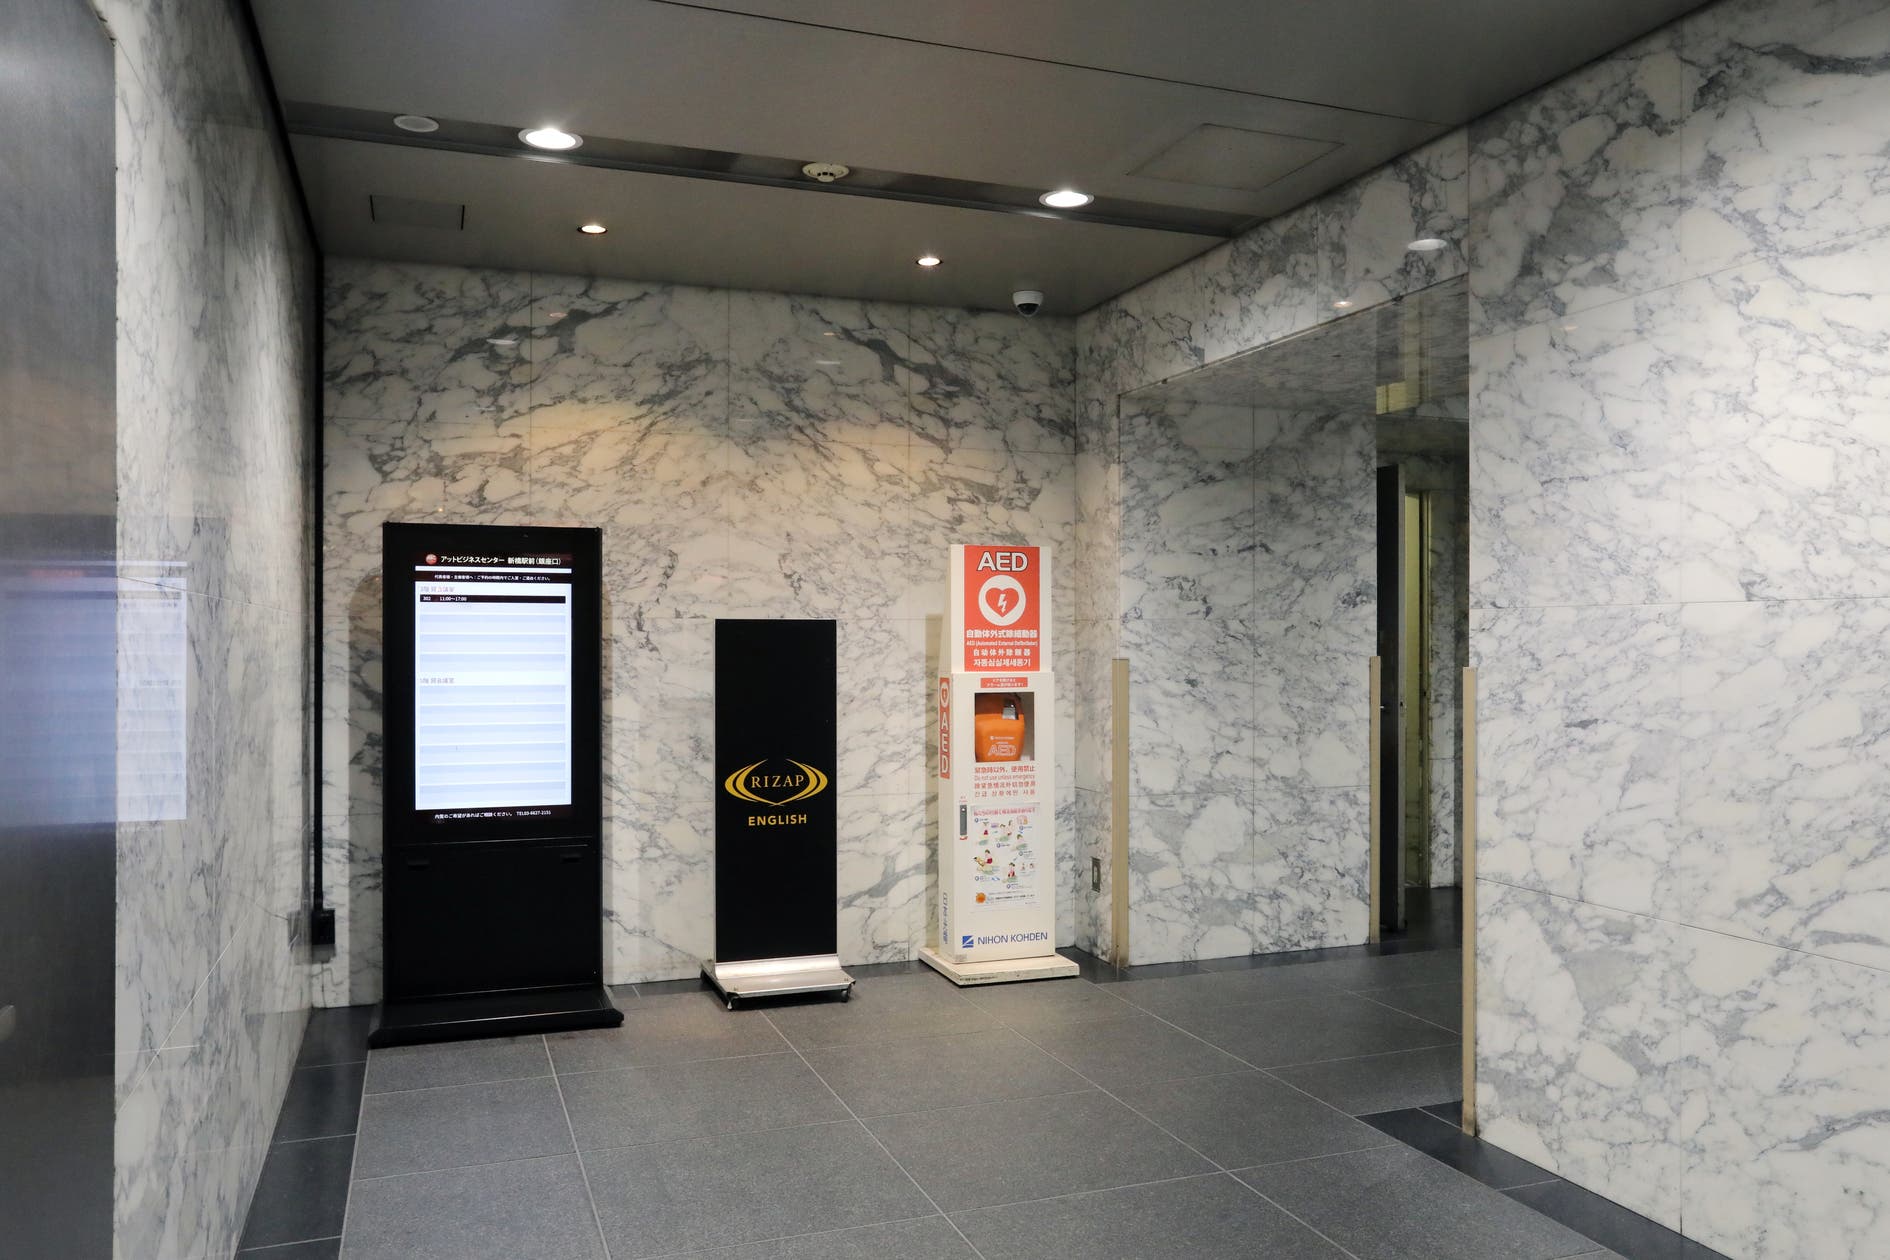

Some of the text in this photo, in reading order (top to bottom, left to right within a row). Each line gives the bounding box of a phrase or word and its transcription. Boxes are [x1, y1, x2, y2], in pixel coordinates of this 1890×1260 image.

[440, 555, 505, 564] アットビジネスセンター
[977, 551, 1028, 572] AED
[941, 712, 949, 774] AED
[988, 745, 1016, 757] AED
[751, 774, 805, 788] RIZAP
[748, 814, 807, 826] ENGLISH
[977, 932, 1048, 945] NIHON KOHDEN
